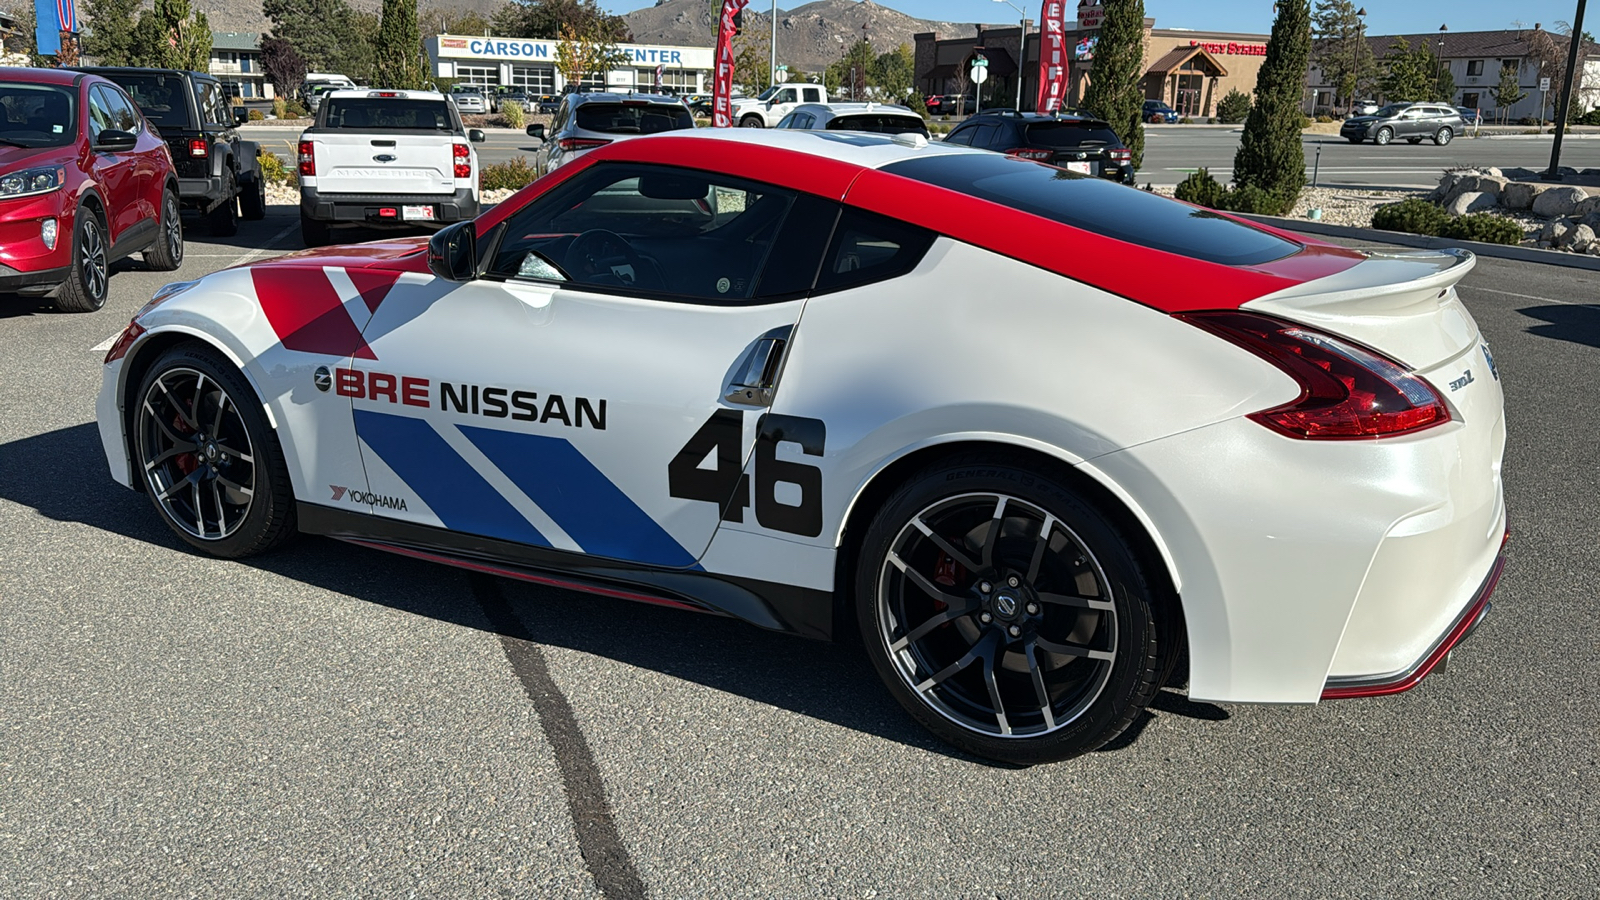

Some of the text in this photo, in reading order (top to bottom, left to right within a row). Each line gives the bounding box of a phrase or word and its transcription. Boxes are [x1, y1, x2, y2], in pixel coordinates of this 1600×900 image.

[470, 40, 547, 57] CARSON
[608, 47, 681, 63] ENTER
[1046, 2, 1063, 111] ERTIFIE
[336, 169, 435, 178] MAVERICK
[335, 368, 607, 430] BRE NISSAN
[668, 408, 826, 537] 46
[945, 469, 1016, 482] GENERAL
[347, 489, 408, 512] YOKOHAMA
